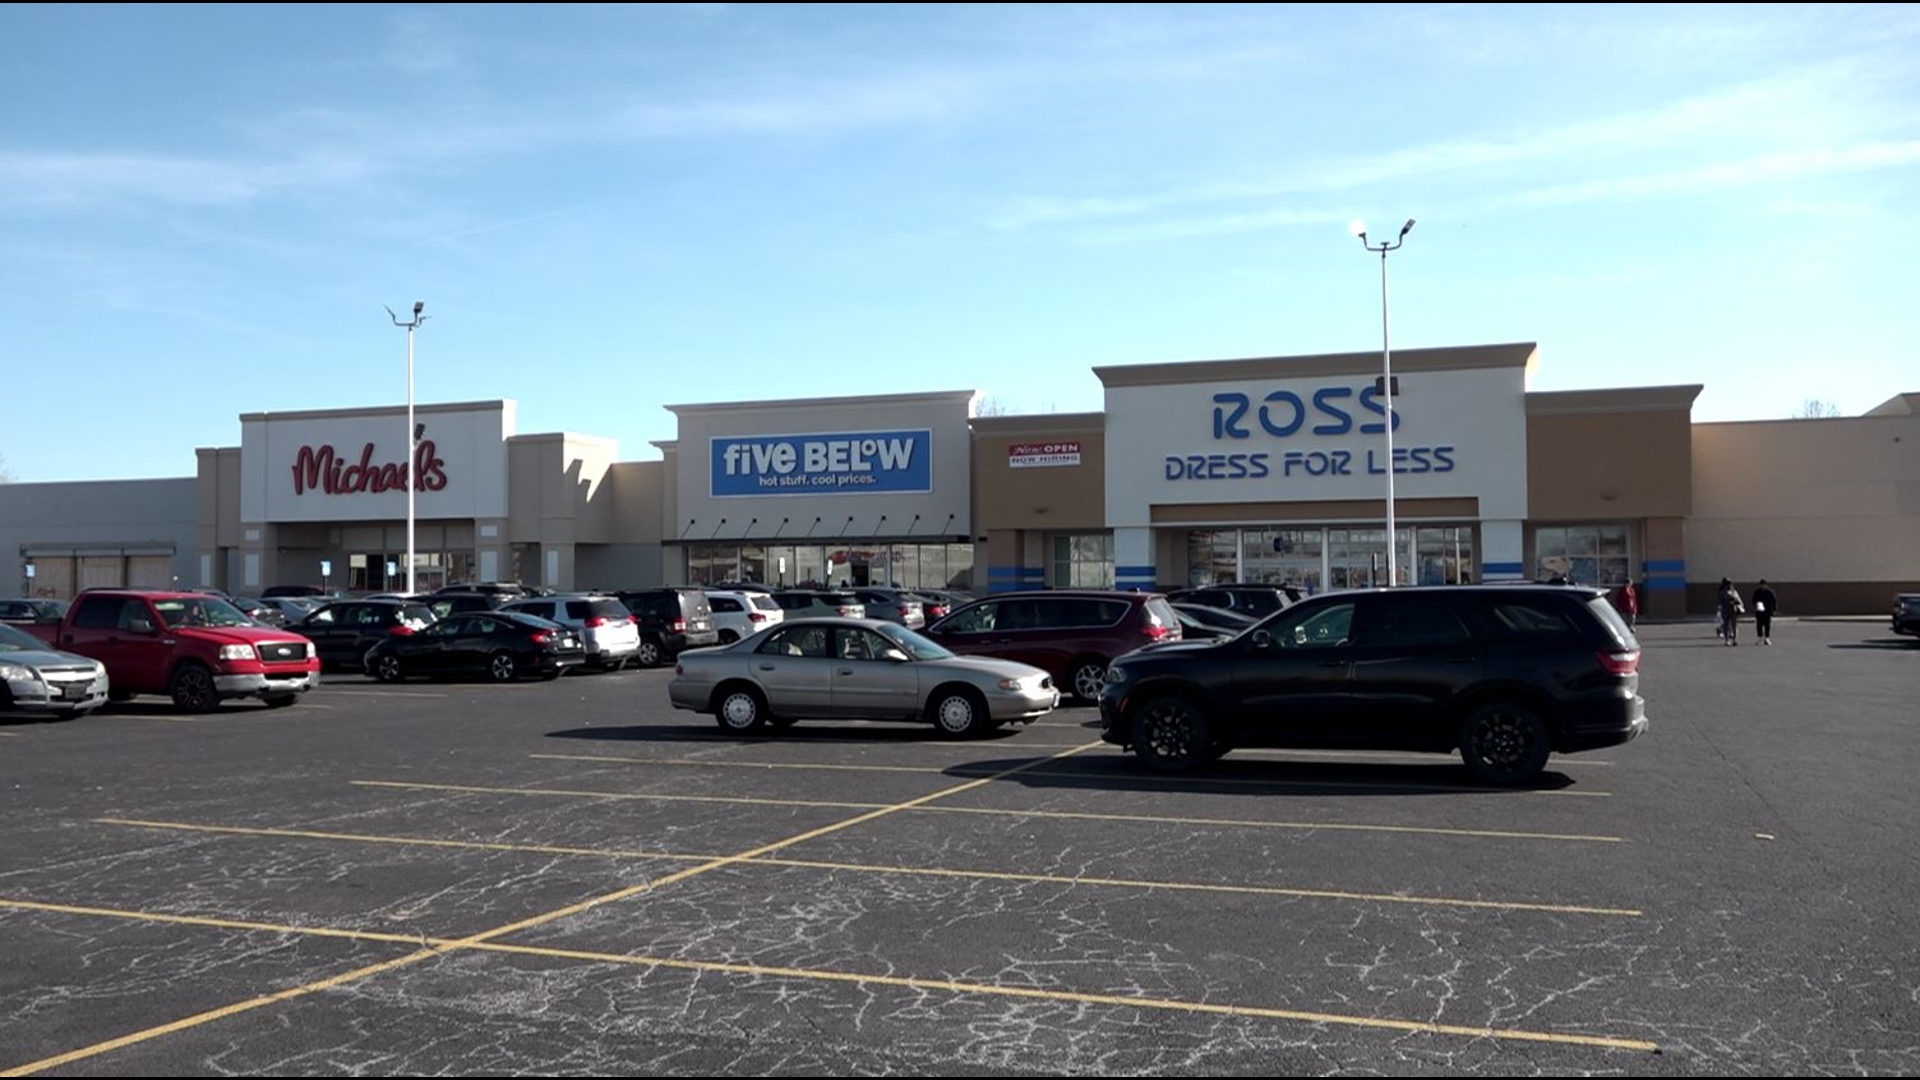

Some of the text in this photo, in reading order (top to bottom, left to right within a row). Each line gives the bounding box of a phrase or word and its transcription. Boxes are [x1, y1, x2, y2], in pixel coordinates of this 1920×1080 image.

[1212, 386, 1400, 439] ROSS
[1043, 443, 1079, 453] OPEN
[1165, 447, 1455, 480] DRESS FOR LESS
[292, 440, 448, 496] Michaels
[759, 473, 877, 487] hot stuff. cool prices.
